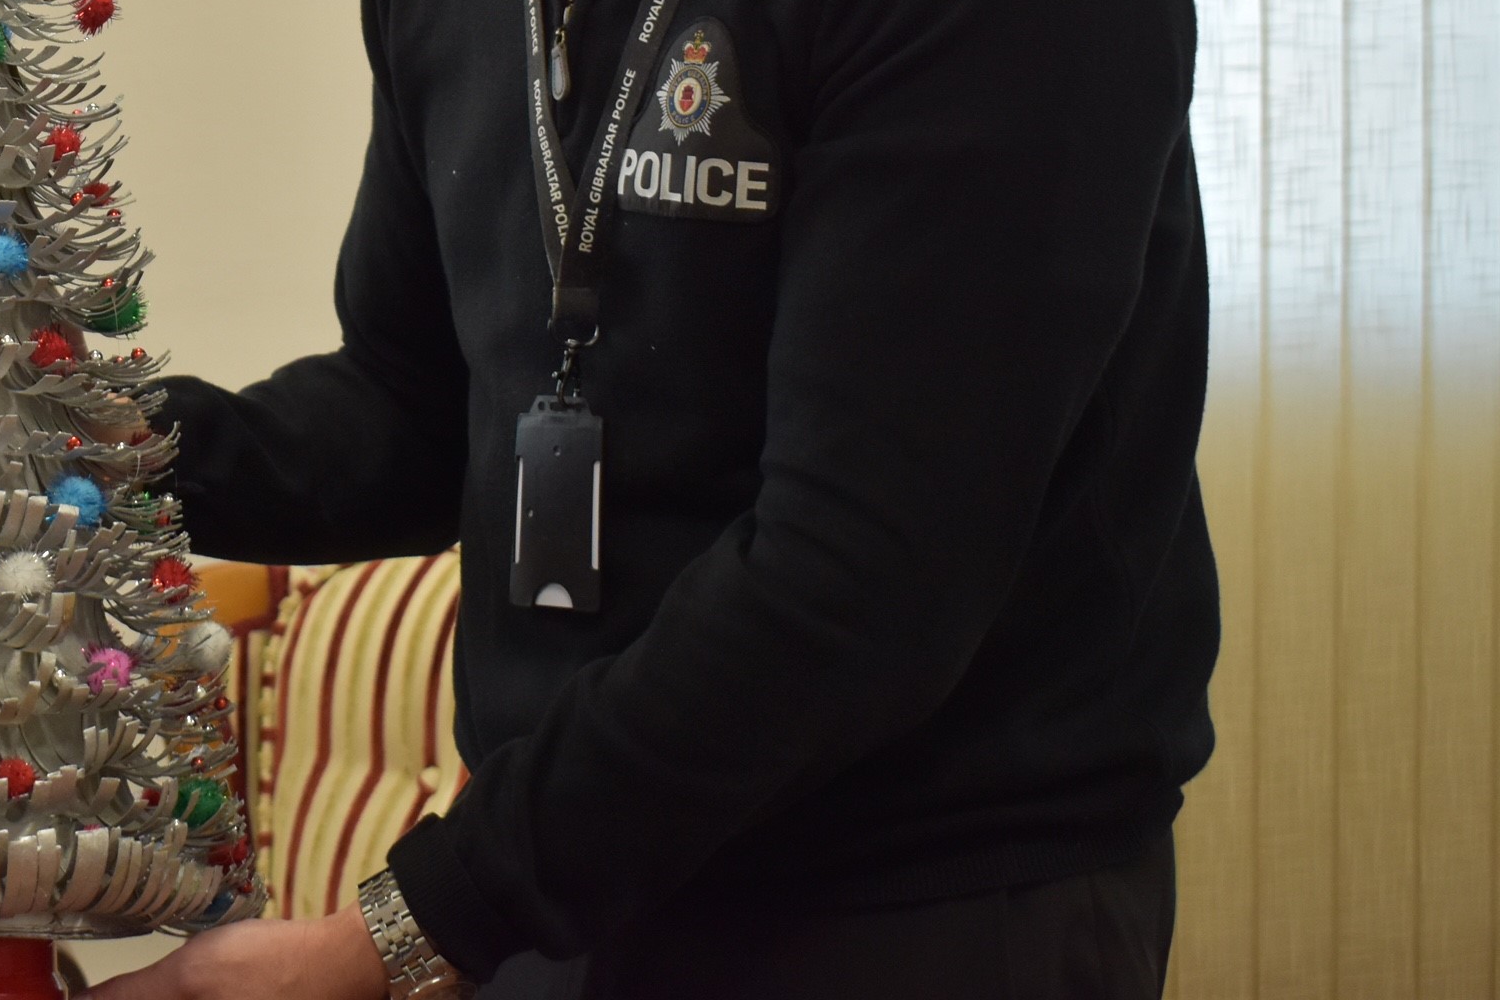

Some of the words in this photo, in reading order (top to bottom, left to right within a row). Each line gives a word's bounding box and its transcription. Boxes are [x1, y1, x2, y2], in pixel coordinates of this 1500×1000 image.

[529, 7, 539, 56] POLICE
[533, 78, 543, 125] ROYAL
[537, 125, 562, 203] GIBRALTAR
[578, 207, 599, 253] ROYAL
[589, 122, 618, 203] GIBRALTAR
[611, 68, 636, 120] POLICE
[617, 148, 770, 211] POLICE
[552, 203, 569, 247] POLI
